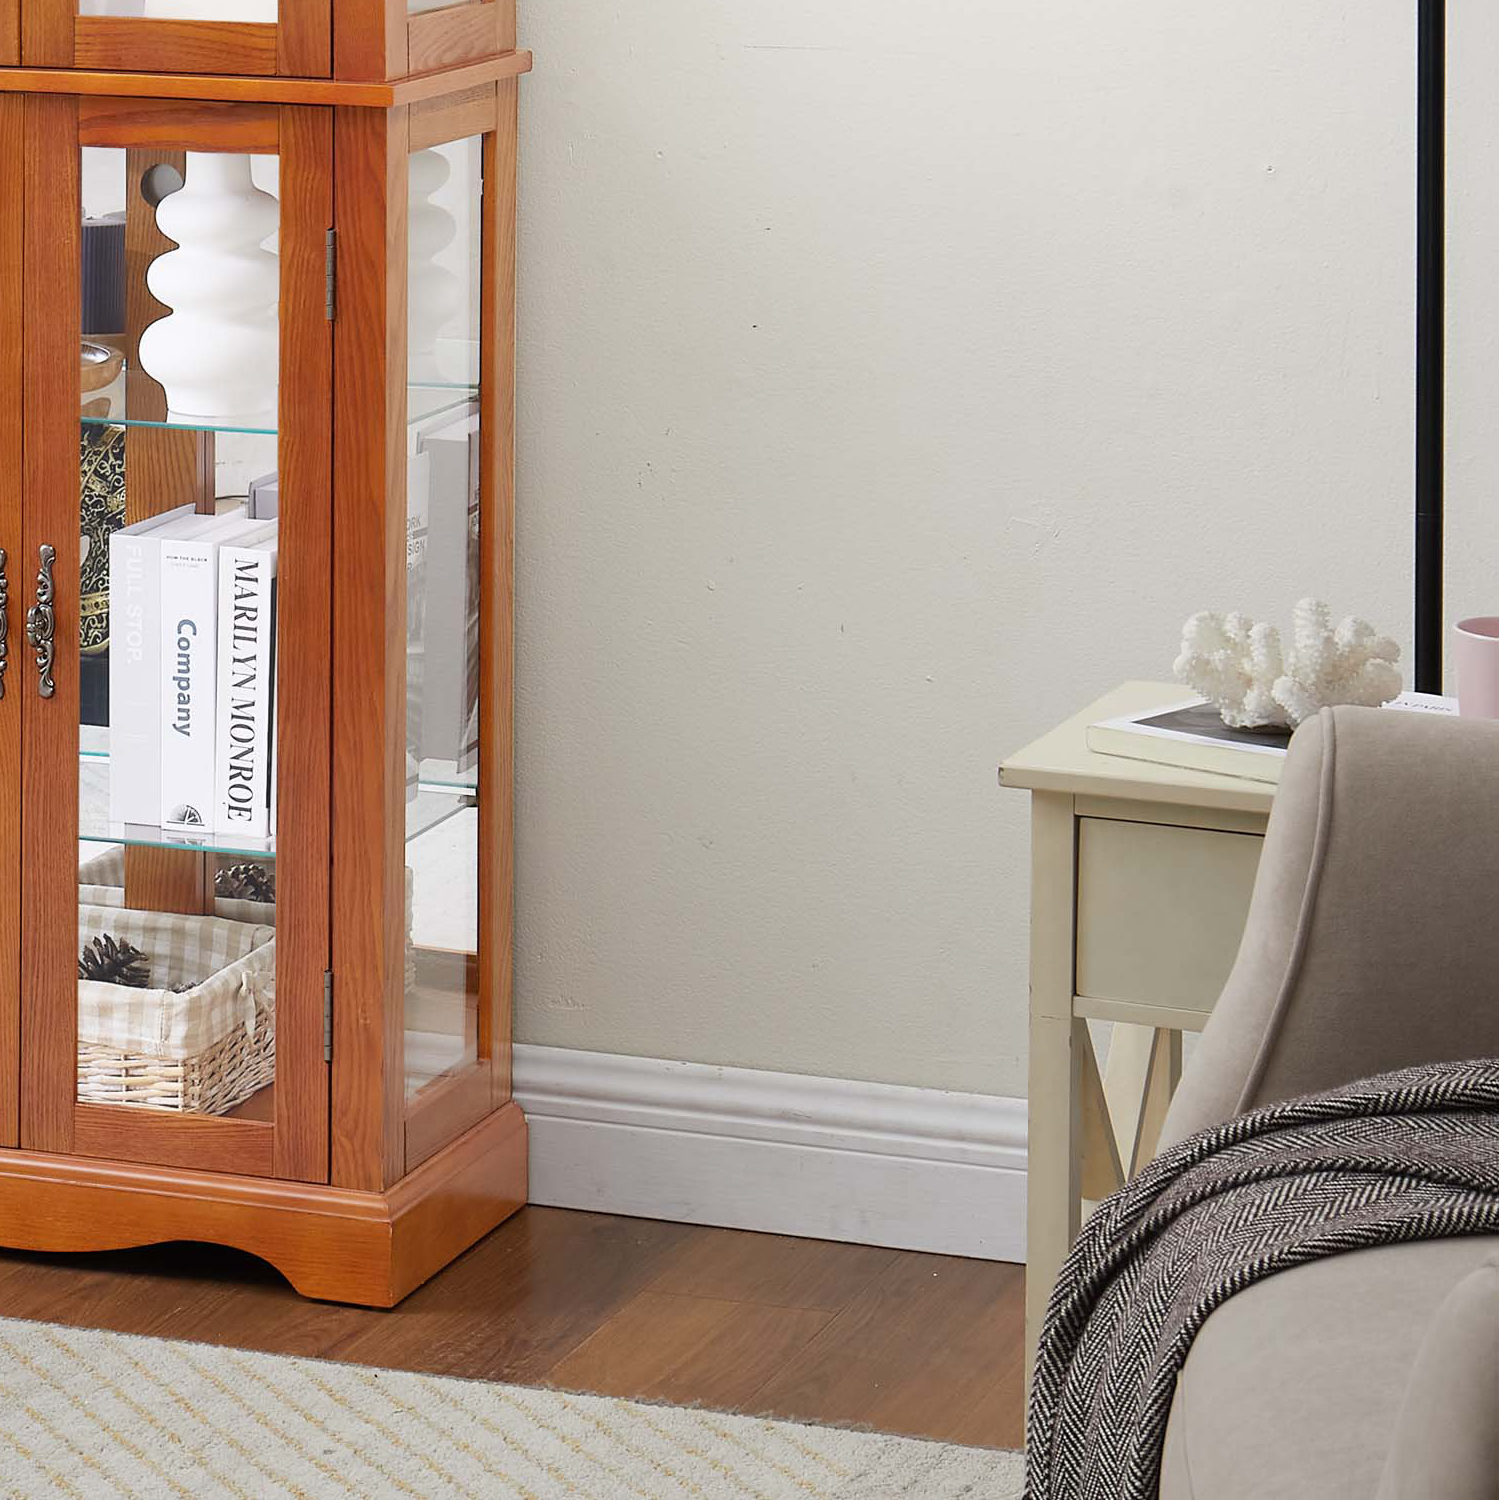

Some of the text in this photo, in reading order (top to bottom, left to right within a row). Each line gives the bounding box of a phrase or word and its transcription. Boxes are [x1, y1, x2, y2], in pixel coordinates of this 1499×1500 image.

[126, 544, 143, 597] FULL
[172, 618, 197, 737] Company
[228, 559, 259, 822] MARILYN MONROE
